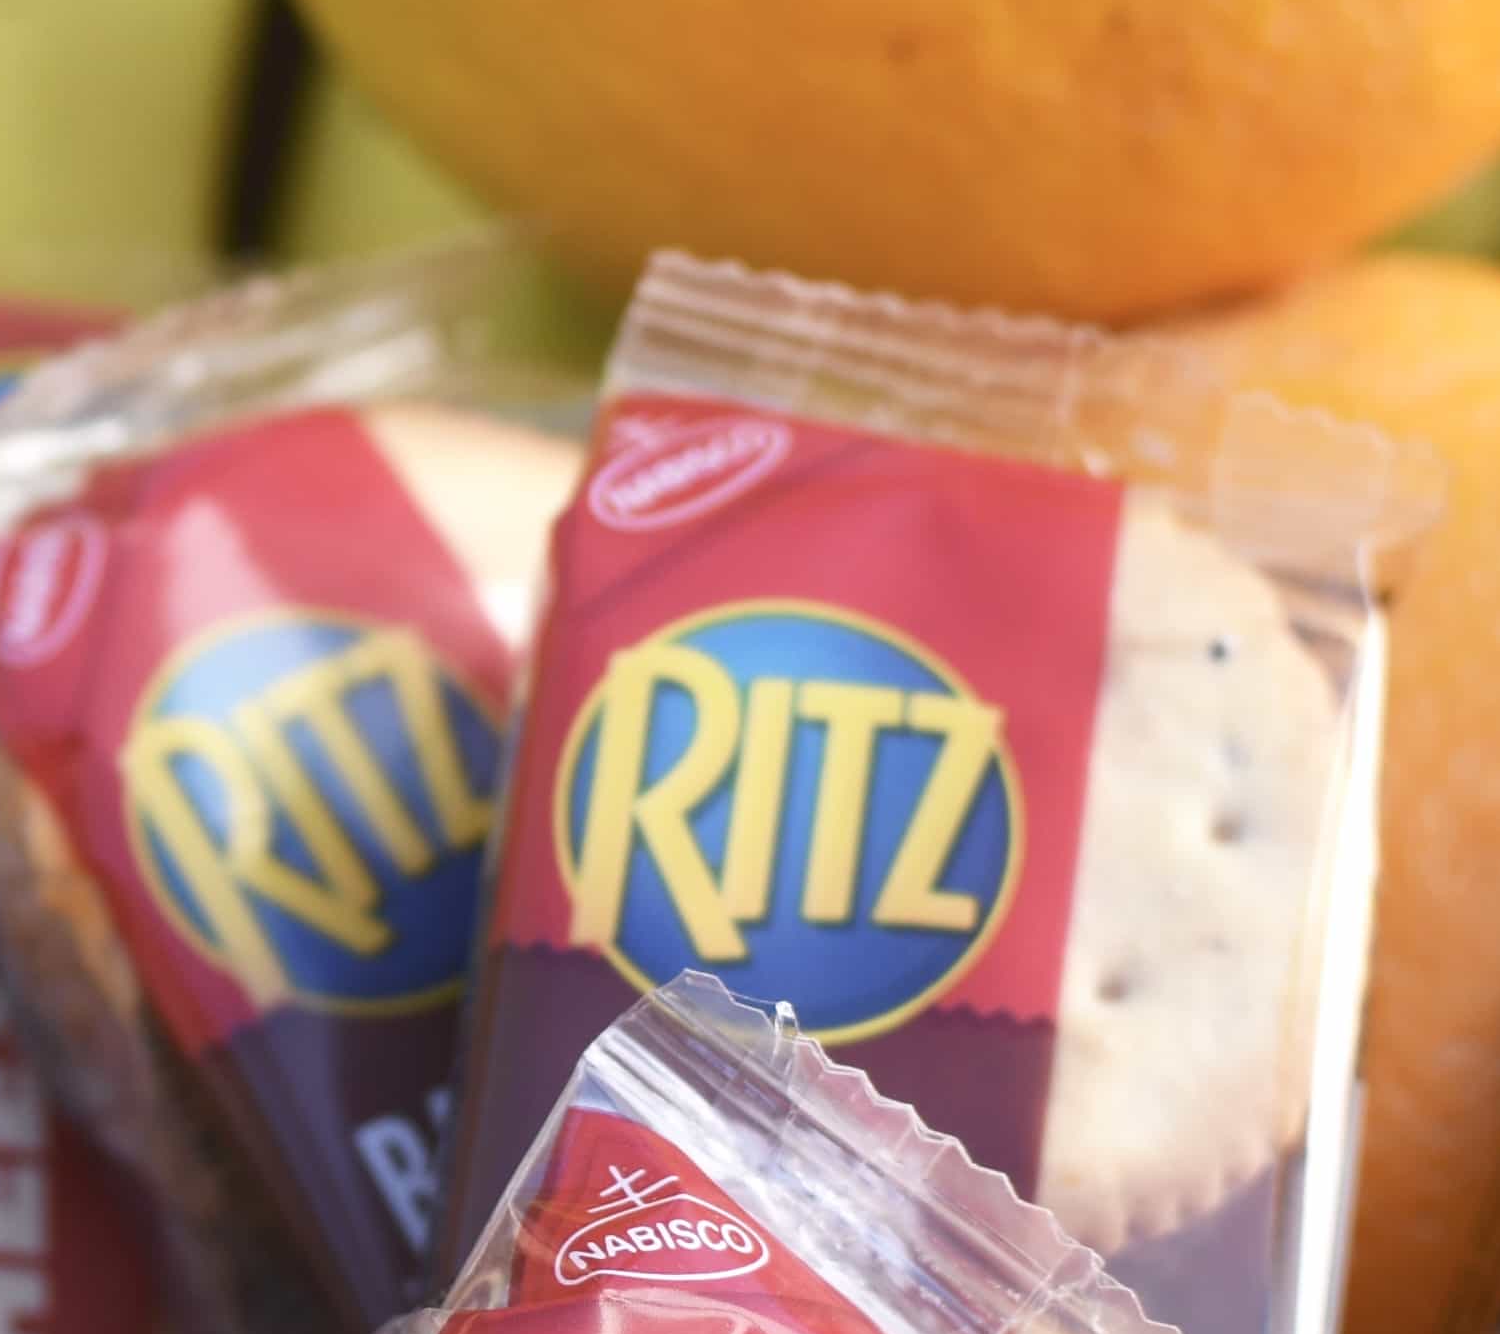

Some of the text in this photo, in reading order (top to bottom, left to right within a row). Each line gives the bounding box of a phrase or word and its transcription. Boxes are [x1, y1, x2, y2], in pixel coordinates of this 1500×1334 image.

[121, 627, 497, 1005] RITZ
[572, 644, 1003, 962] RITZ
[569, 1221, 753, 1268] NABISCO
